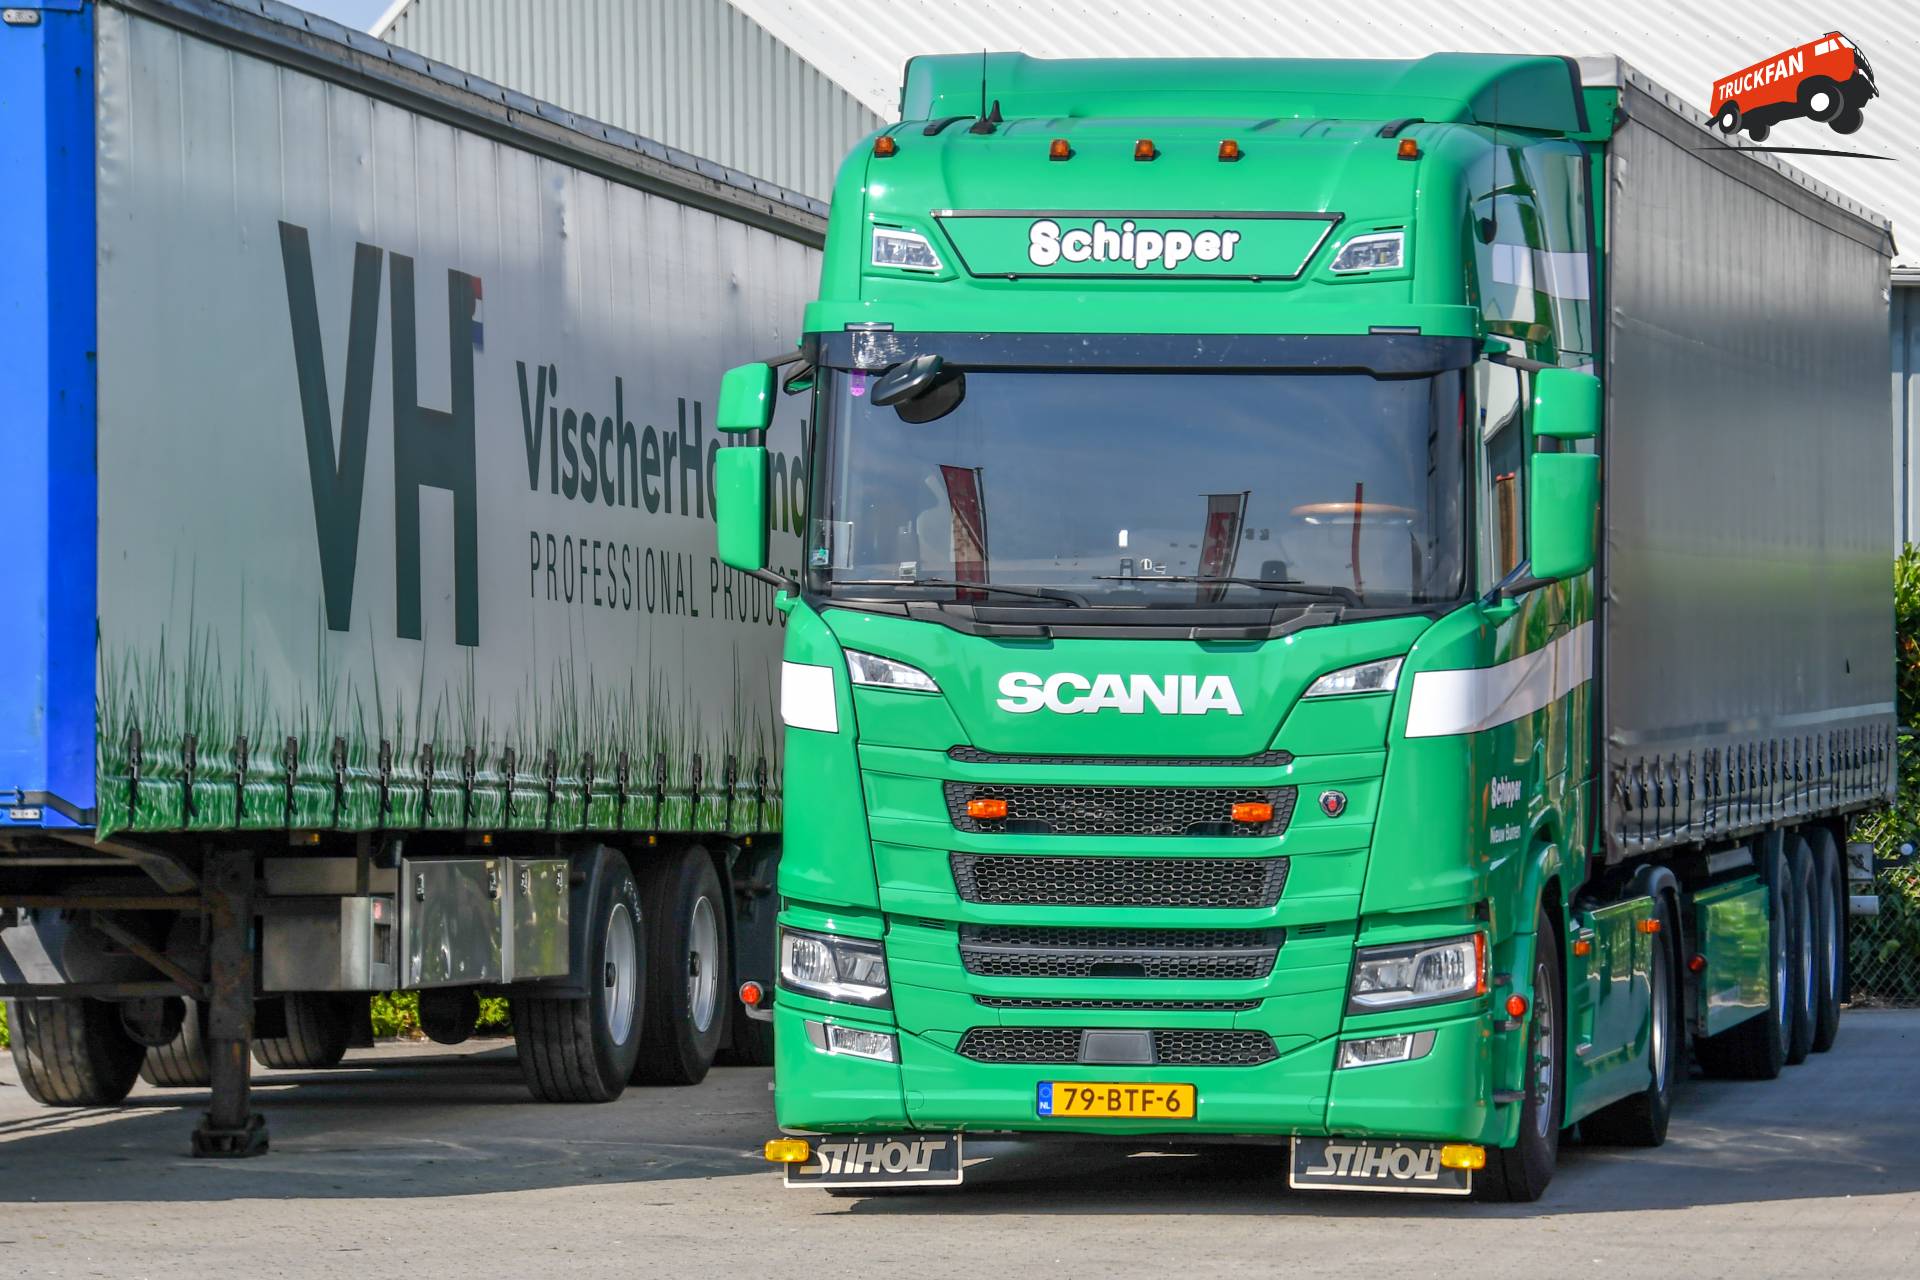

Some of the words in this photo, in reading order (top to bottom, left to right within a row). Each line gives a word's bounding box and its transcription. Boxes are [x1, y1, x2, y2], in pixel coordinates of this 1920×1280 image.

[1028, 219, 1241, 270] Schipper
[278, 220, 480, 647] VH
[516, 360, 807, 538] VisscherHond
[530, 530, 699, 617] PROFESSIONAL
[996, 671, 1244, 716] SCANIA
[1491, 775, 1521, 809] Schipper
[1039, 1101, 1051, 1110] NL
[1063, 1087, 1181, 1113] 79-BTF-6
[799, 1140, 947, 1175] STIHOLT
